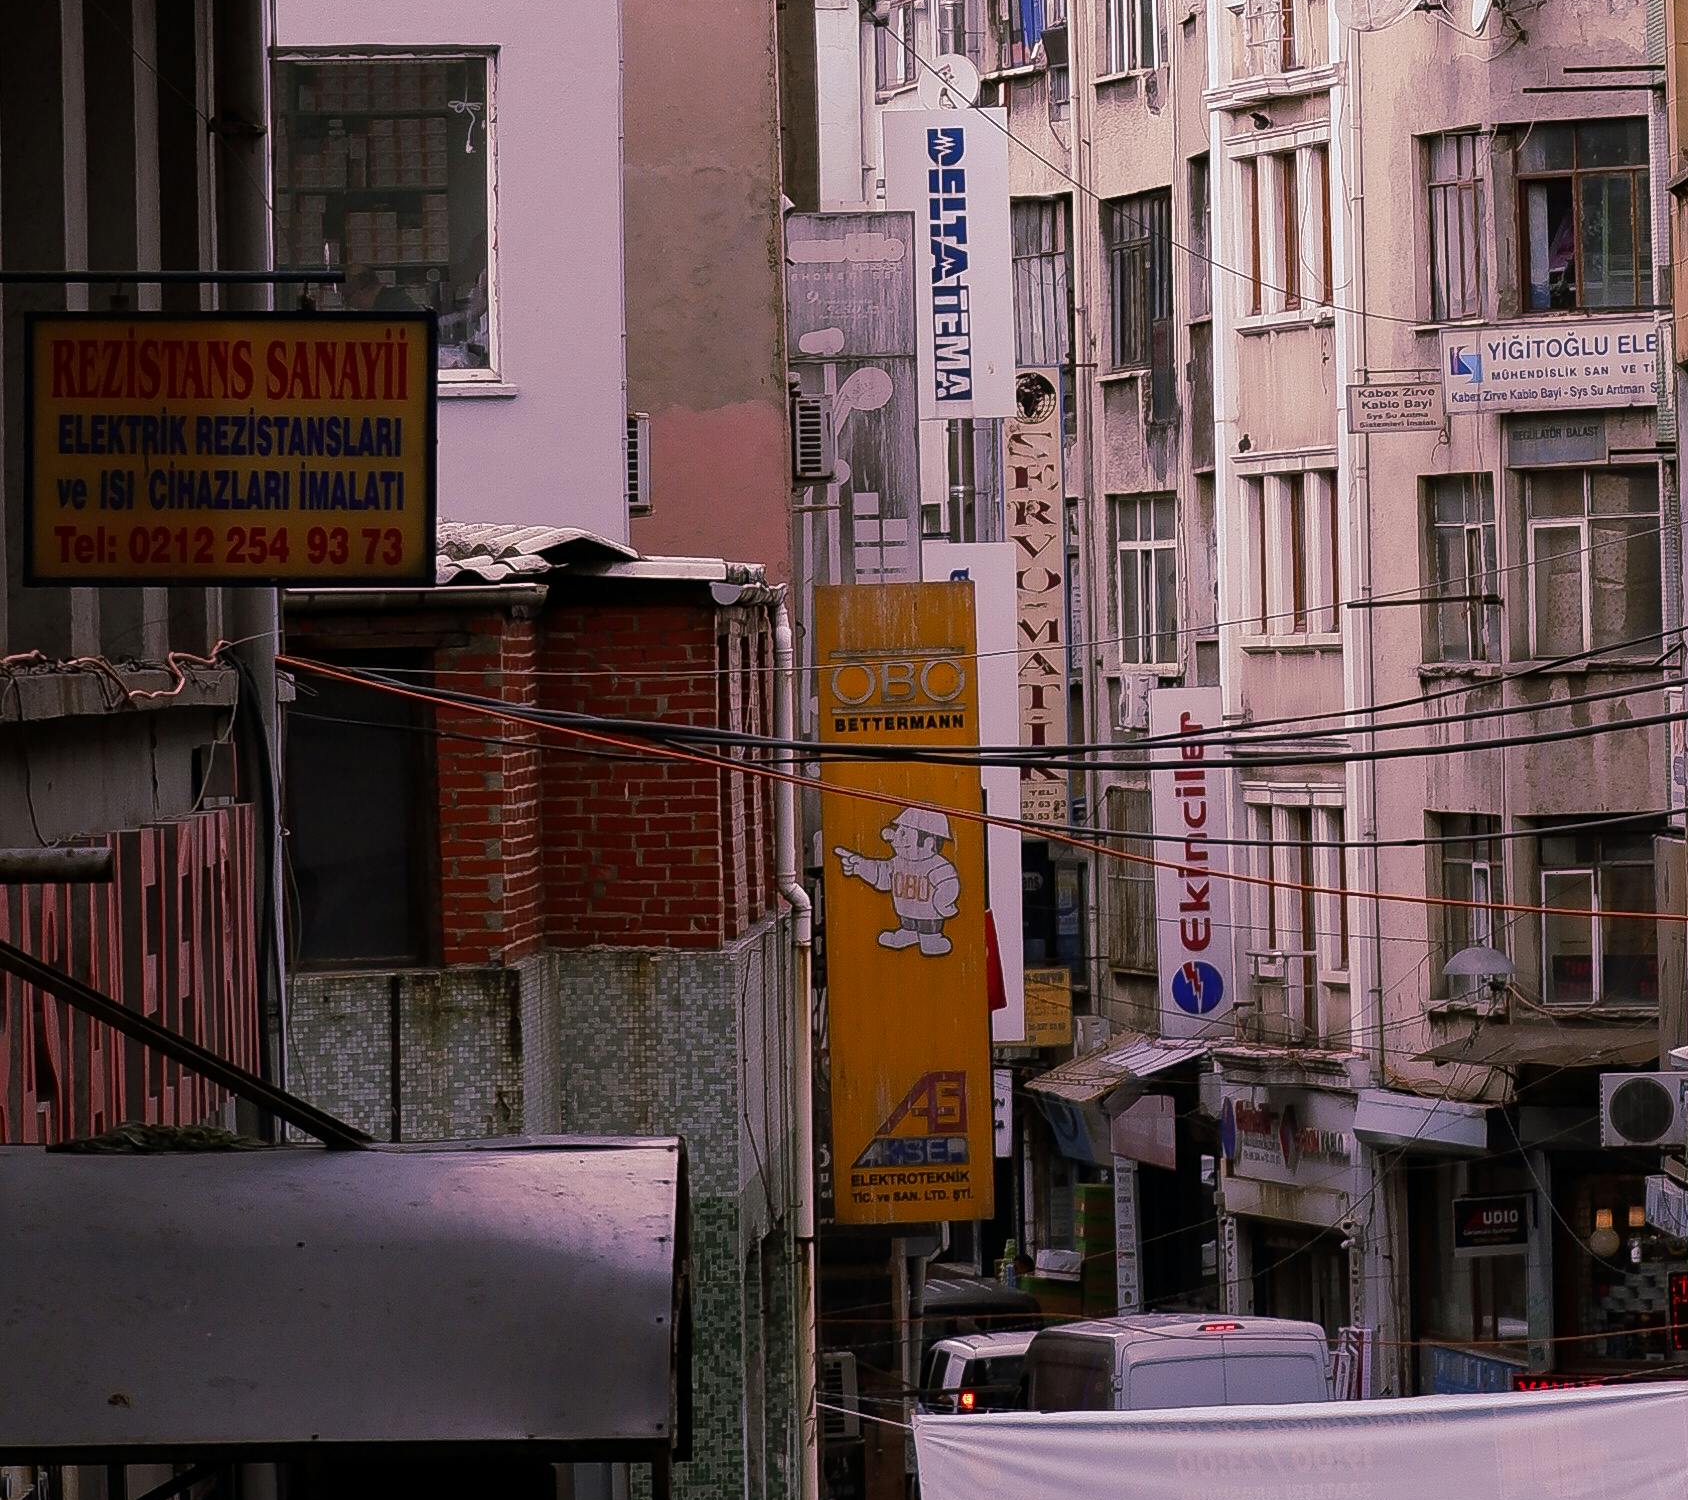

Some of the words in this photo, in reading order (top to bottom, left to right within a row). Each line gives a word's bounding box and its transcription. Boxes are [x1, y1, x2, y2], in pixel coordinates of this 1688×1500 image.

[1487, 331, 1609, 362] YİĞİTOĞLU
[52, 326, 255, 400] REZİSTANS
[265, 327, 410, 401] SANAYİİ
[1490, 363, 1578, 382] MÜHENDİSLİK
[1584, 363, 1610, 377] SAN
[1621, 362, 1637, 375] VE
[1404, 399, 1432, 410] Bayi
[1483, 389, 1507, 402] Zirve
[1509, 387, 1539, 400] Kablo
[1540, 385, 1562, 401] Bayi
[1569, 385, 1589, 400] Sys
[1590, 383, 1604, 396] Su
[58, 407, 188, 455] ELEKTRİK
[195, 407, 403, 457] REZİSTANSLARI
[57, 475, 88, 510] ve
[100, 469, 134, 512] ISI
[149, 460, 290, 512] CİHAZLARI
[299, 461, 405, 512] İMALATI
[54, 525, 117, 565] Tel:
[128, 525, 215, 566] 0212
[226, 525, 290, 566] 254
[307, 526, 350, 566] 93
[361, 527, 403, 567] 73
[830, 660, 967, 706] OBO
[833, 714, 965, 733] BETTERMANN
[850, 1167, 971, 1189] ELEKTROTEKNİK
[892, 1190, 921, 1203] SAN.
[924, 1188, 950, 1202] LTD.
